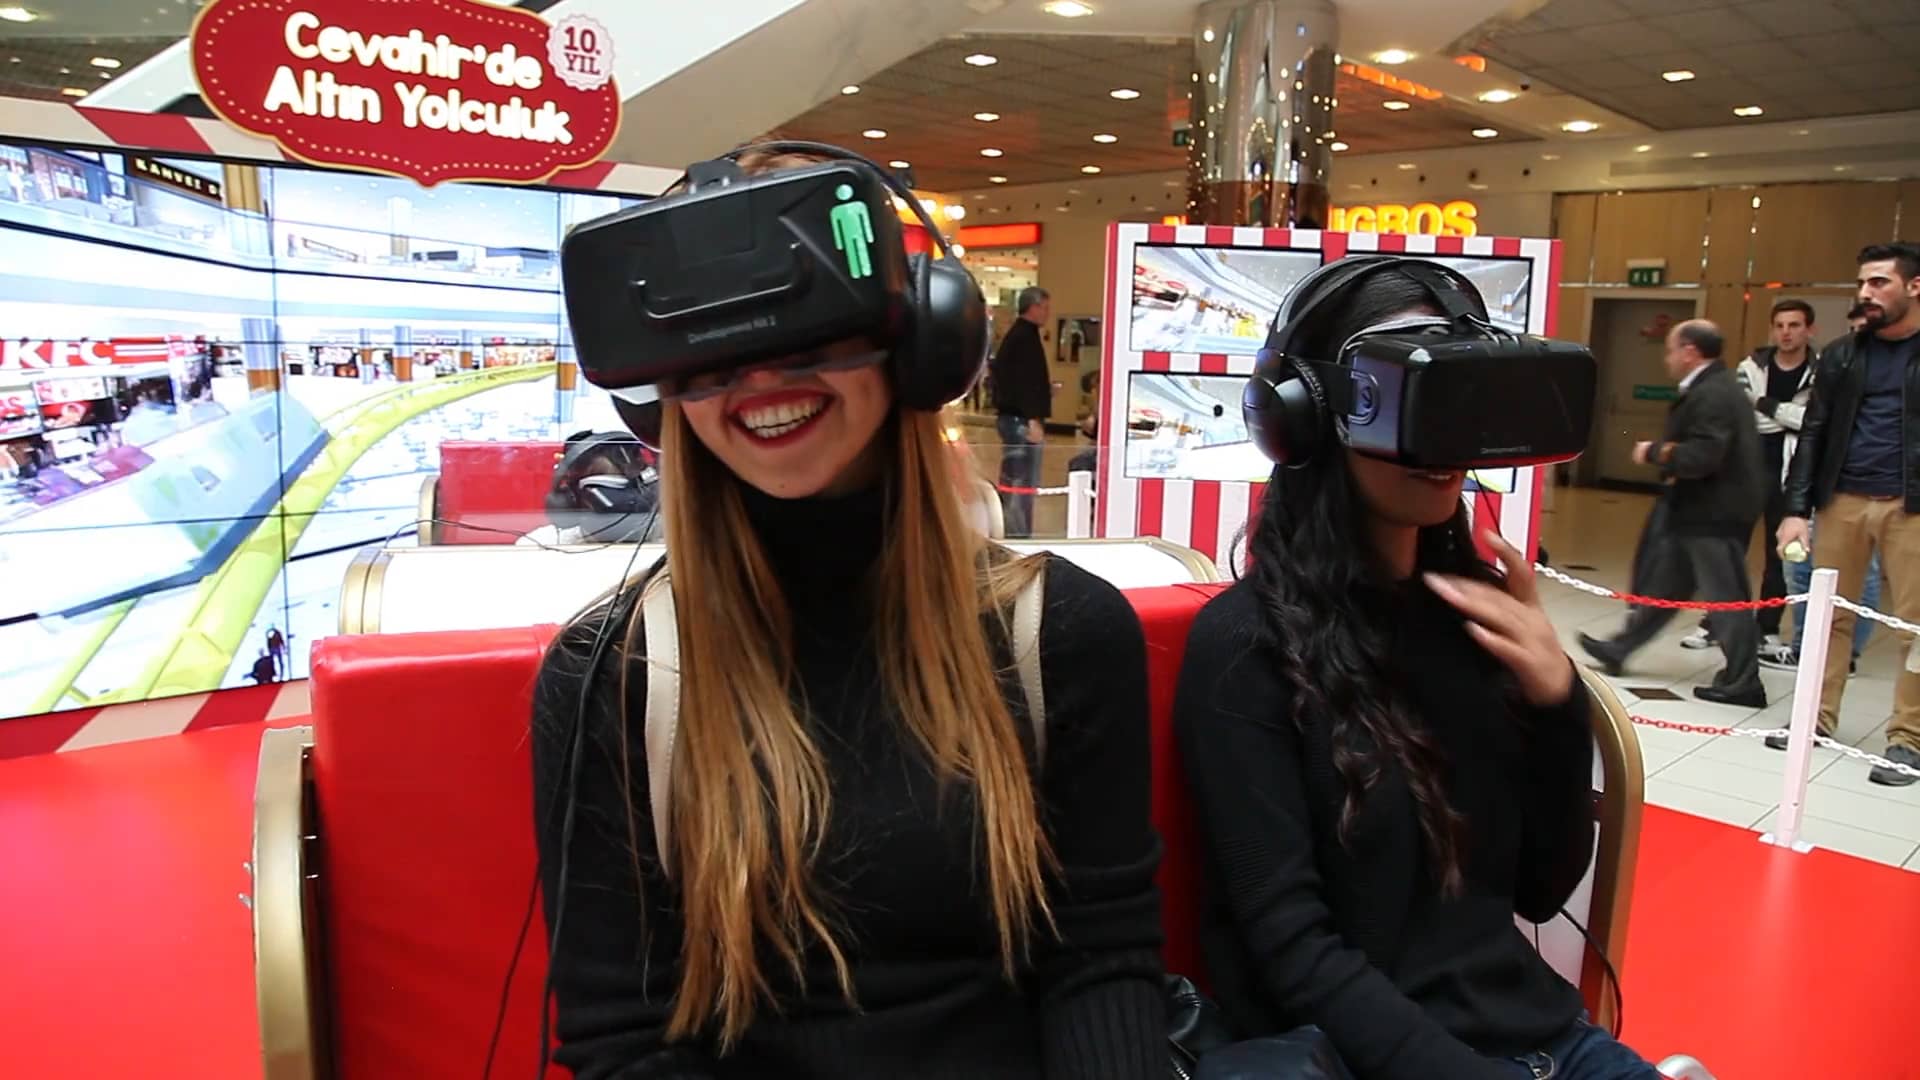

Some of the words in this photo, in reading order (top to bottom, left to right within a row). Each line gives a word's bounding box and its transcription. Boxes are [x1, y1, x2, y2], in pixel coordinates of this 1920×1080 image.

[284, 12, 543, 89] Cevahir'de
[564, 26, 601, 54] 10.
[564, 52, 600, 76] YIL
[264, 66, 382, 123] Altın
[394, 81, 573, 145] Yolculuk
[1328, 200, 1477, 236] IGROS
[2, 339, 112, 369] KFC
